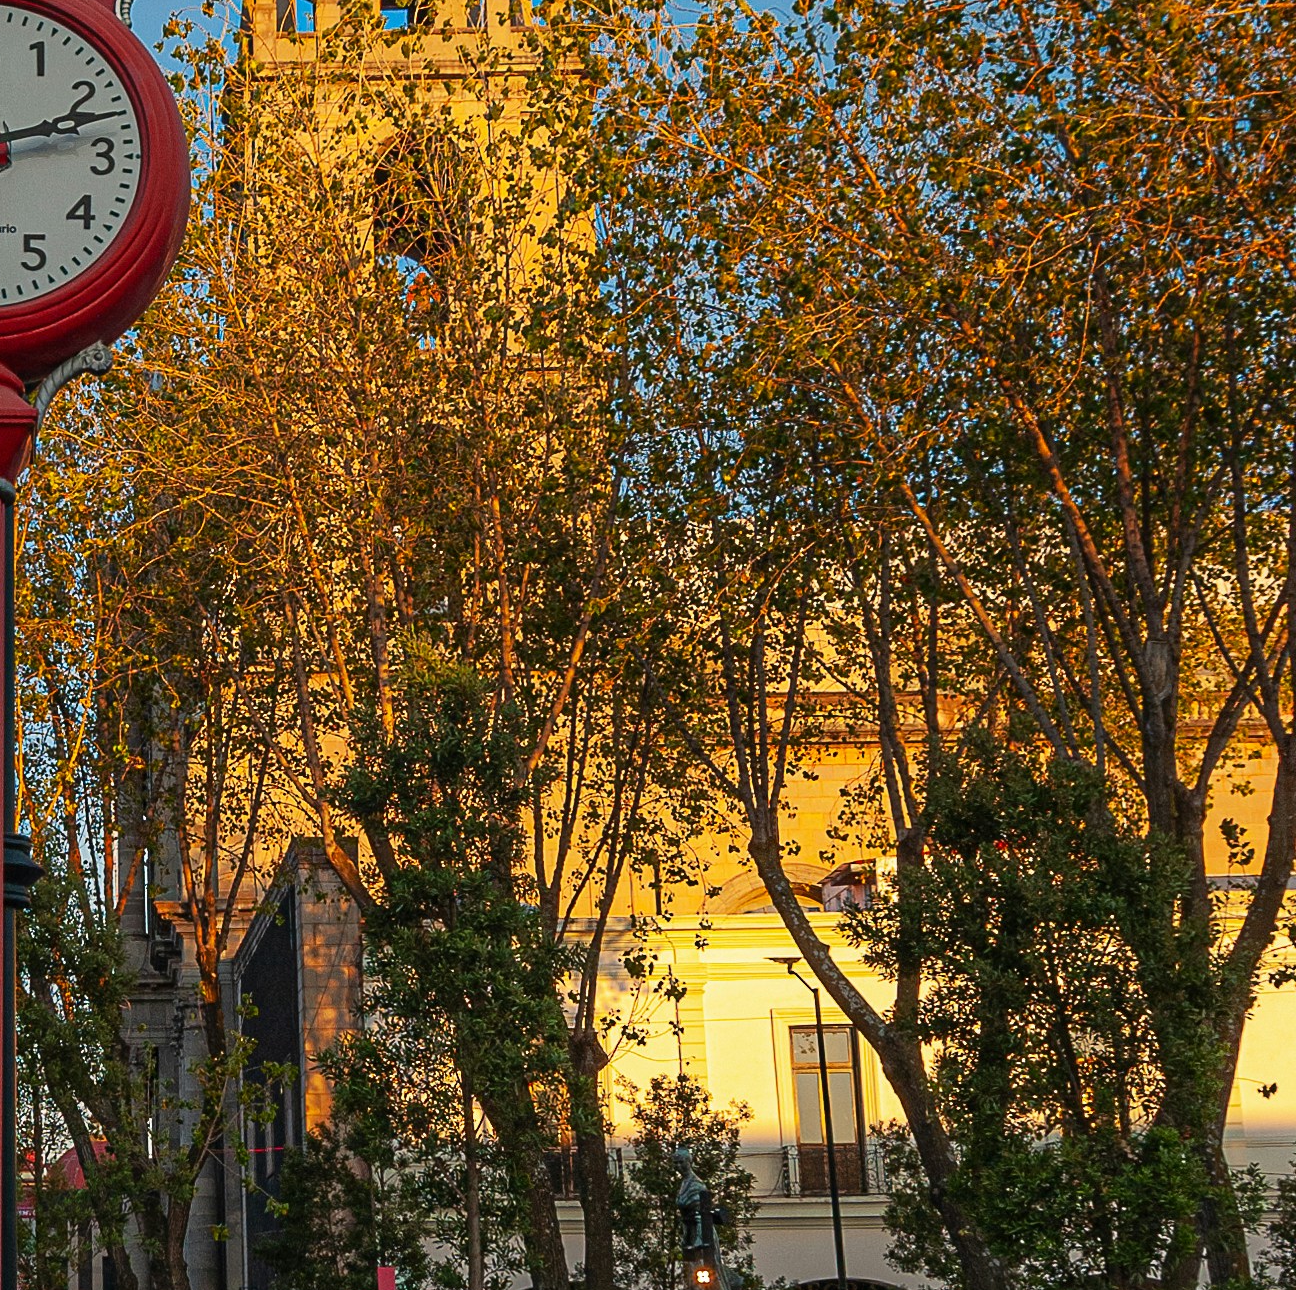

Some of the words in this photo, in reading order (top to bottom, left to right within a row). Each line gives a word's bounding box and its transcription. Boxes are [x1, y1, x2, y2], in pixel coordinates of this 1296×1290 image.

[28, 41, 46, 77] 1
[70, 80, 96, 115] 2
[90, 137, 116, 176] 3
[65, 194, 96, 230] 4
[20, 233, 48, 272] 5
